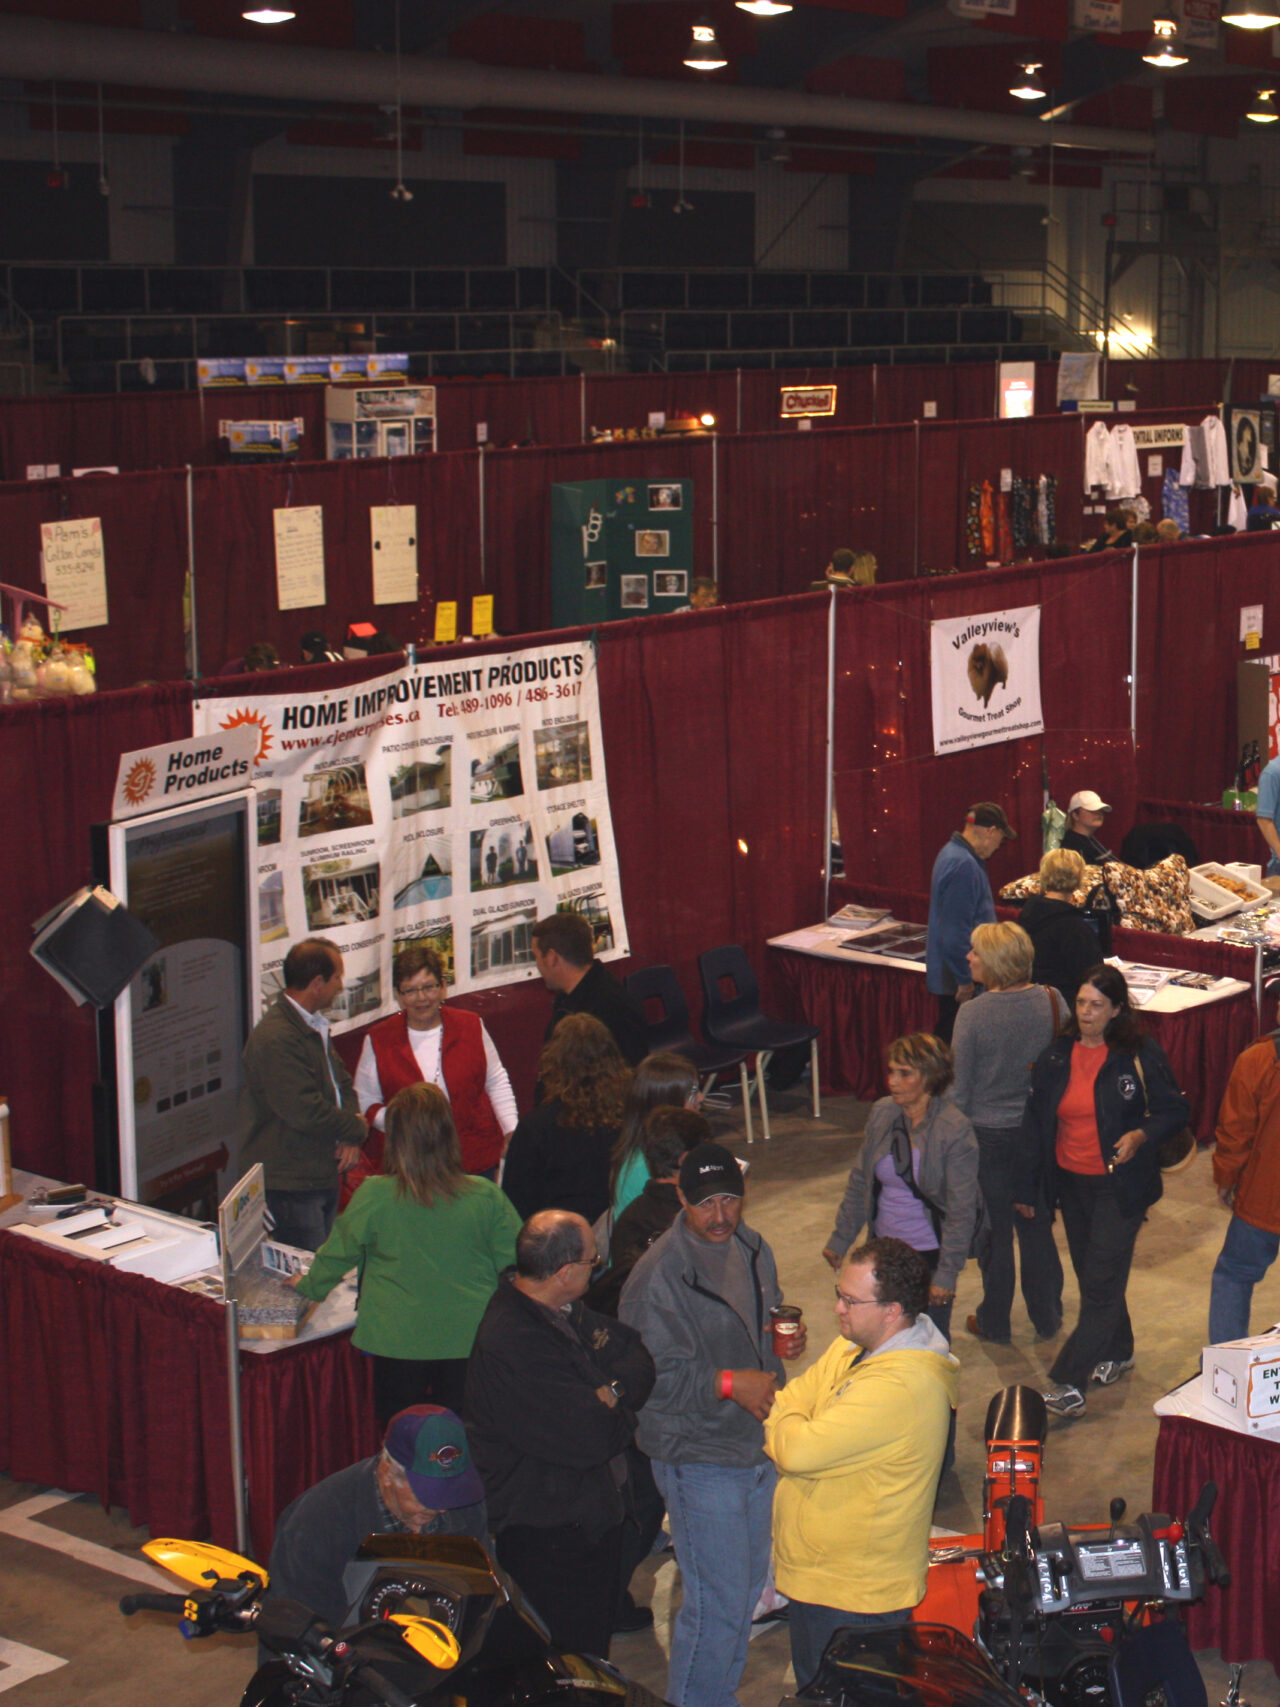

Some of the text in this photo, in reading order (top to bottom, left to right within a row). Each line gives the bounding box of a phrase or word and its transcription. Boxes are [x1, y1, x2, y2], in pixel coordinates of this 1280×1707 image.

[1154, 427, 1184, 443] UNIFORMS
[951, 618, 1021, 650] Valleyview's
[282, 654, 584, 730] HOME IMPROVEMENT PRODUCTS
[281, 710, 421, 751] www.cjenterpses.ca
[526, 681, 584, 703] 486-3617
[957, 696, 1023, 723] Gourmet Treat Shop
[167, 746, 223, 773] Home
[163, 759, 249, 795] Products
[257, 863, 277, 874] NROOM
[262, 959, 284, 971] SUNROO
